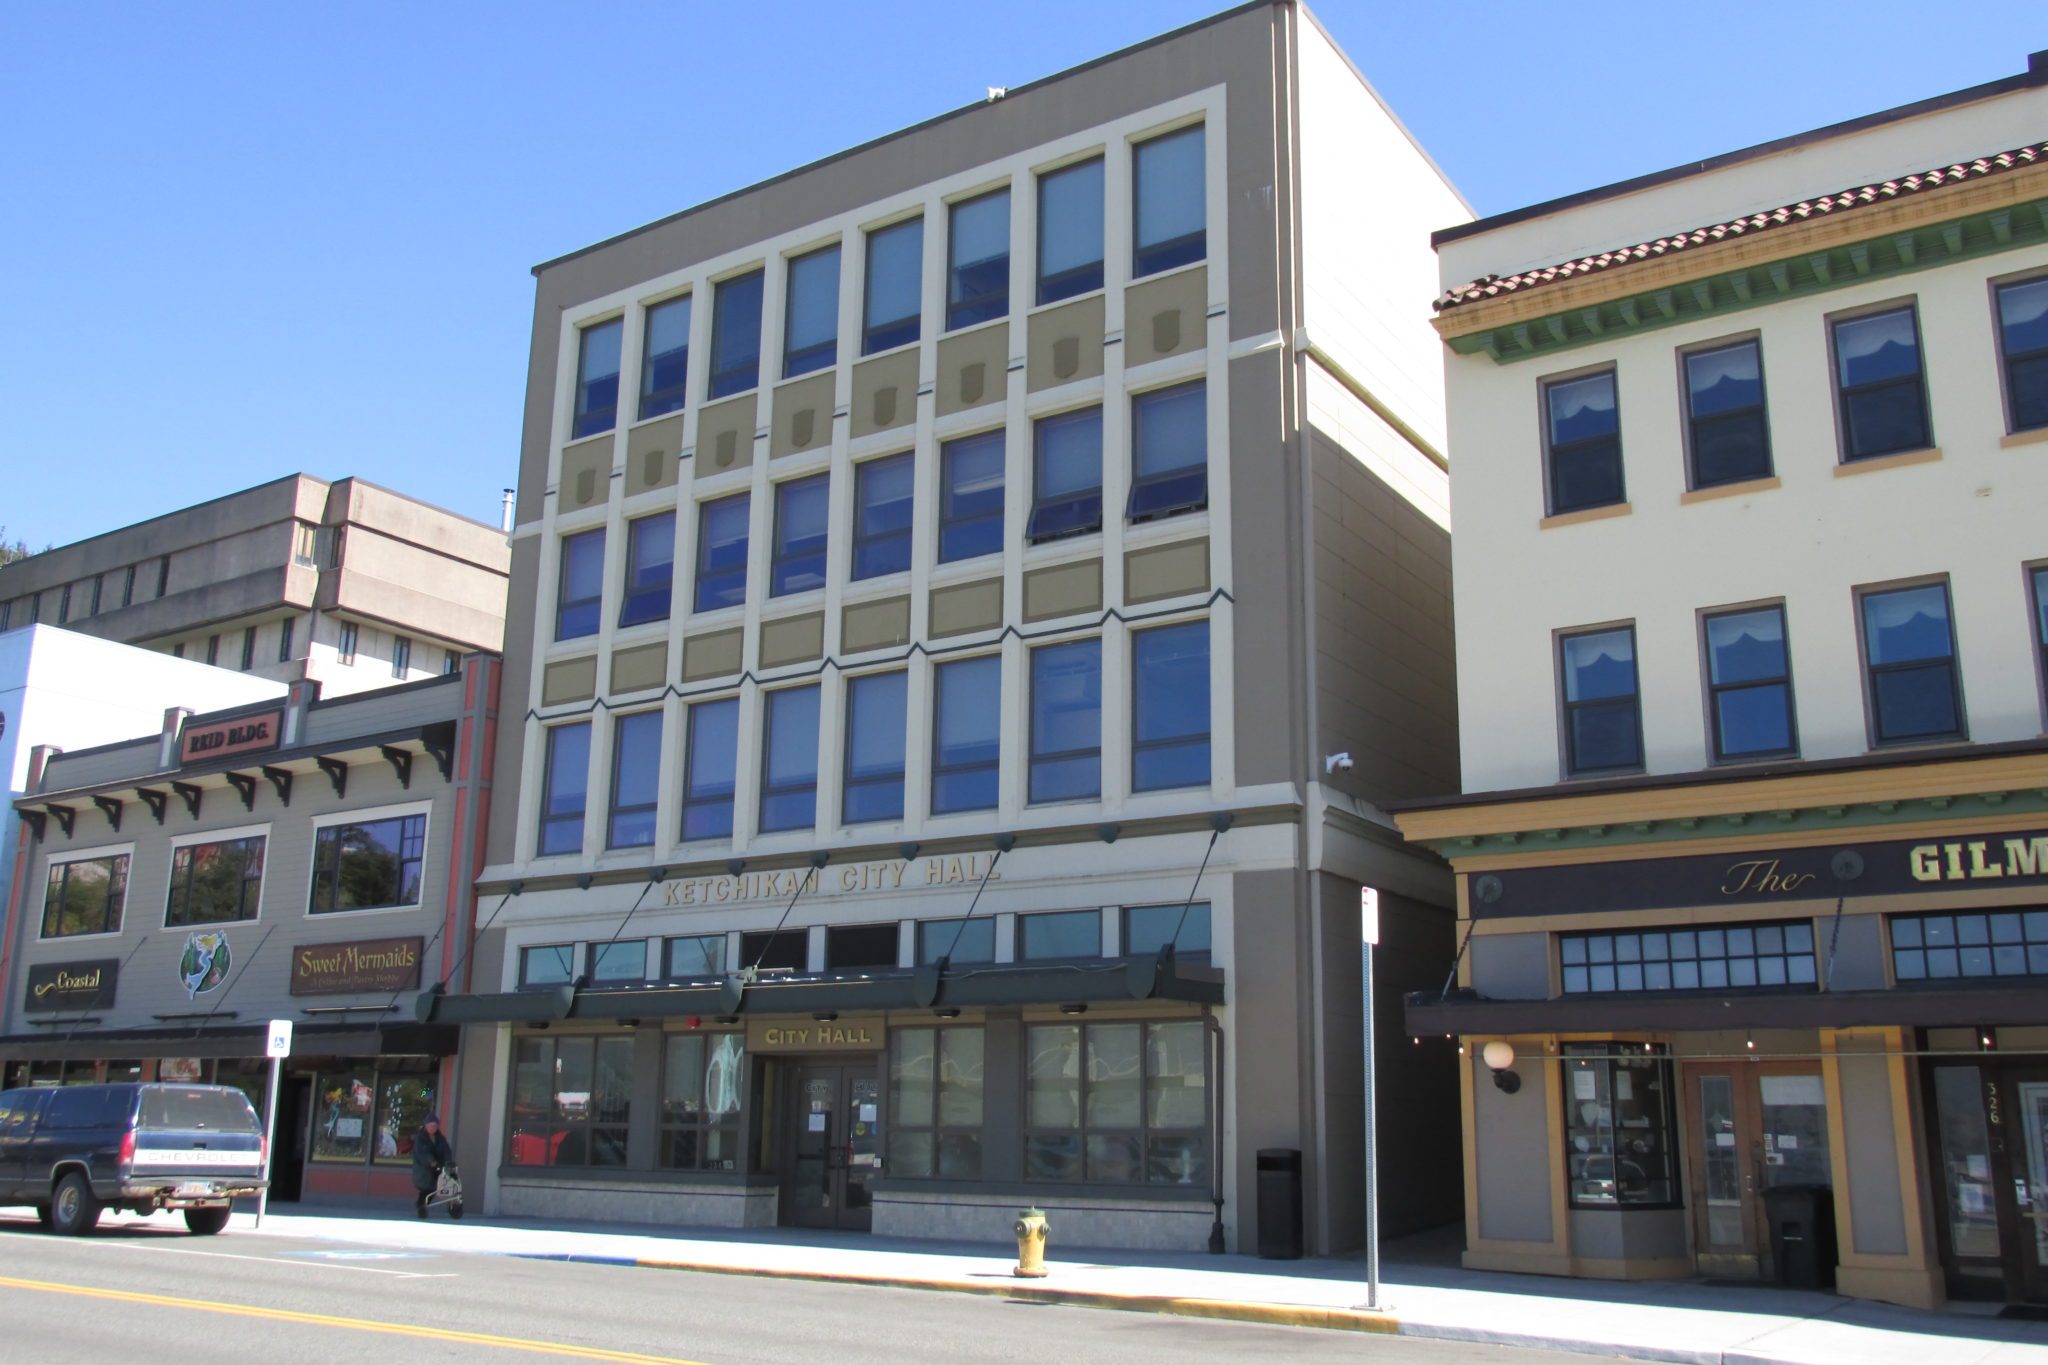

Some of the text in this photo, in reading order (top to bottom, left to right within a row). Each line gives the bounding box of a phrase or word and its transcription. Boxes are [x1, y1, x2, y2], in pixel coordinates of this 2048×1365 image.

[189, 722, 269, 753] REID BLDG.
[664, 854, 1001, 906] KETCHIKAN CITY HALL
[1720, 837, 2048, 895] The GILM
[300, 944, 415, 977] Sweet Mermaids
[57, 968, 101, 989] Coastal
[765, 1027, 872, 1045] CITY HALL
[148, 1152, 248, 1162] CHEVROLET
